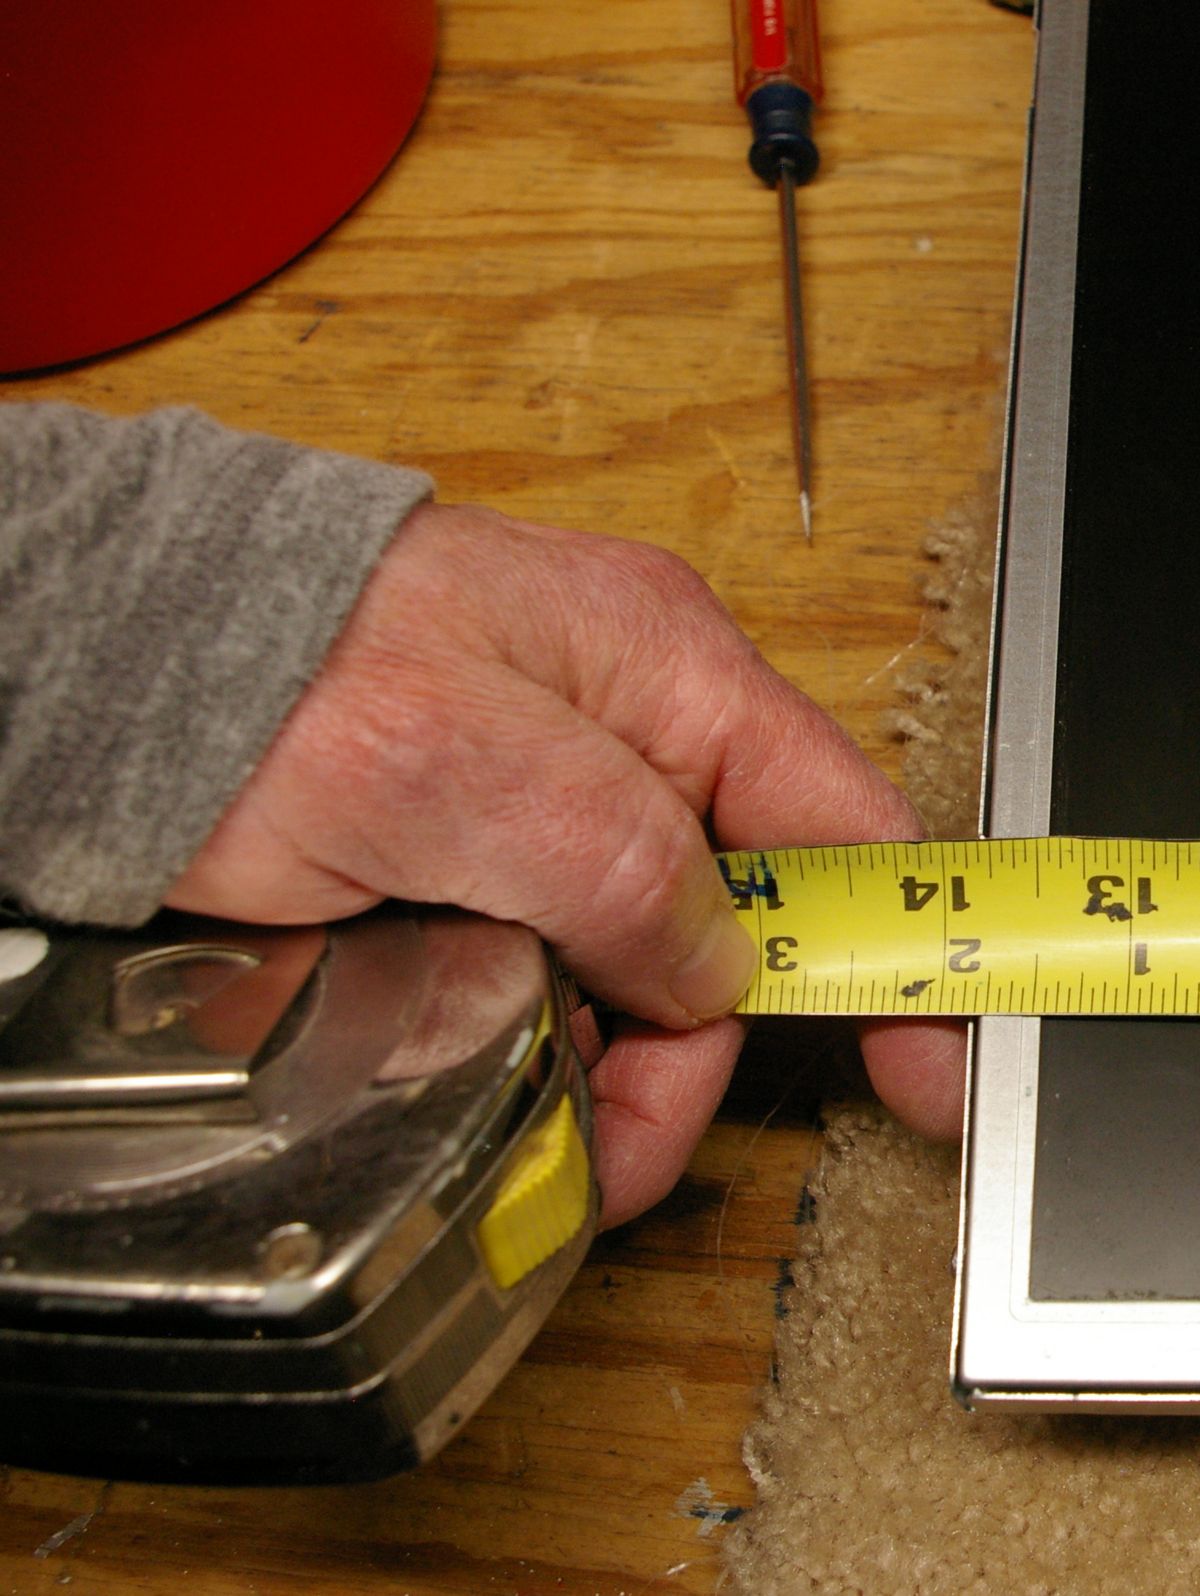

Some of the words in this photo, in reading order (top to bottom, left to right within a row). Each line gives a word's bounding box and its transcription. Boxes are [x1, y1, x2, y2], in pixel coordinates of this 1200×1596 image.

[899, 875, 971, 912] 14
[1085, 874, 1158, 916] 13
[765, 936, 799, 972] 3
[949, 938, 982, 973] 2
[1134, 942, 1151, 976] 1
